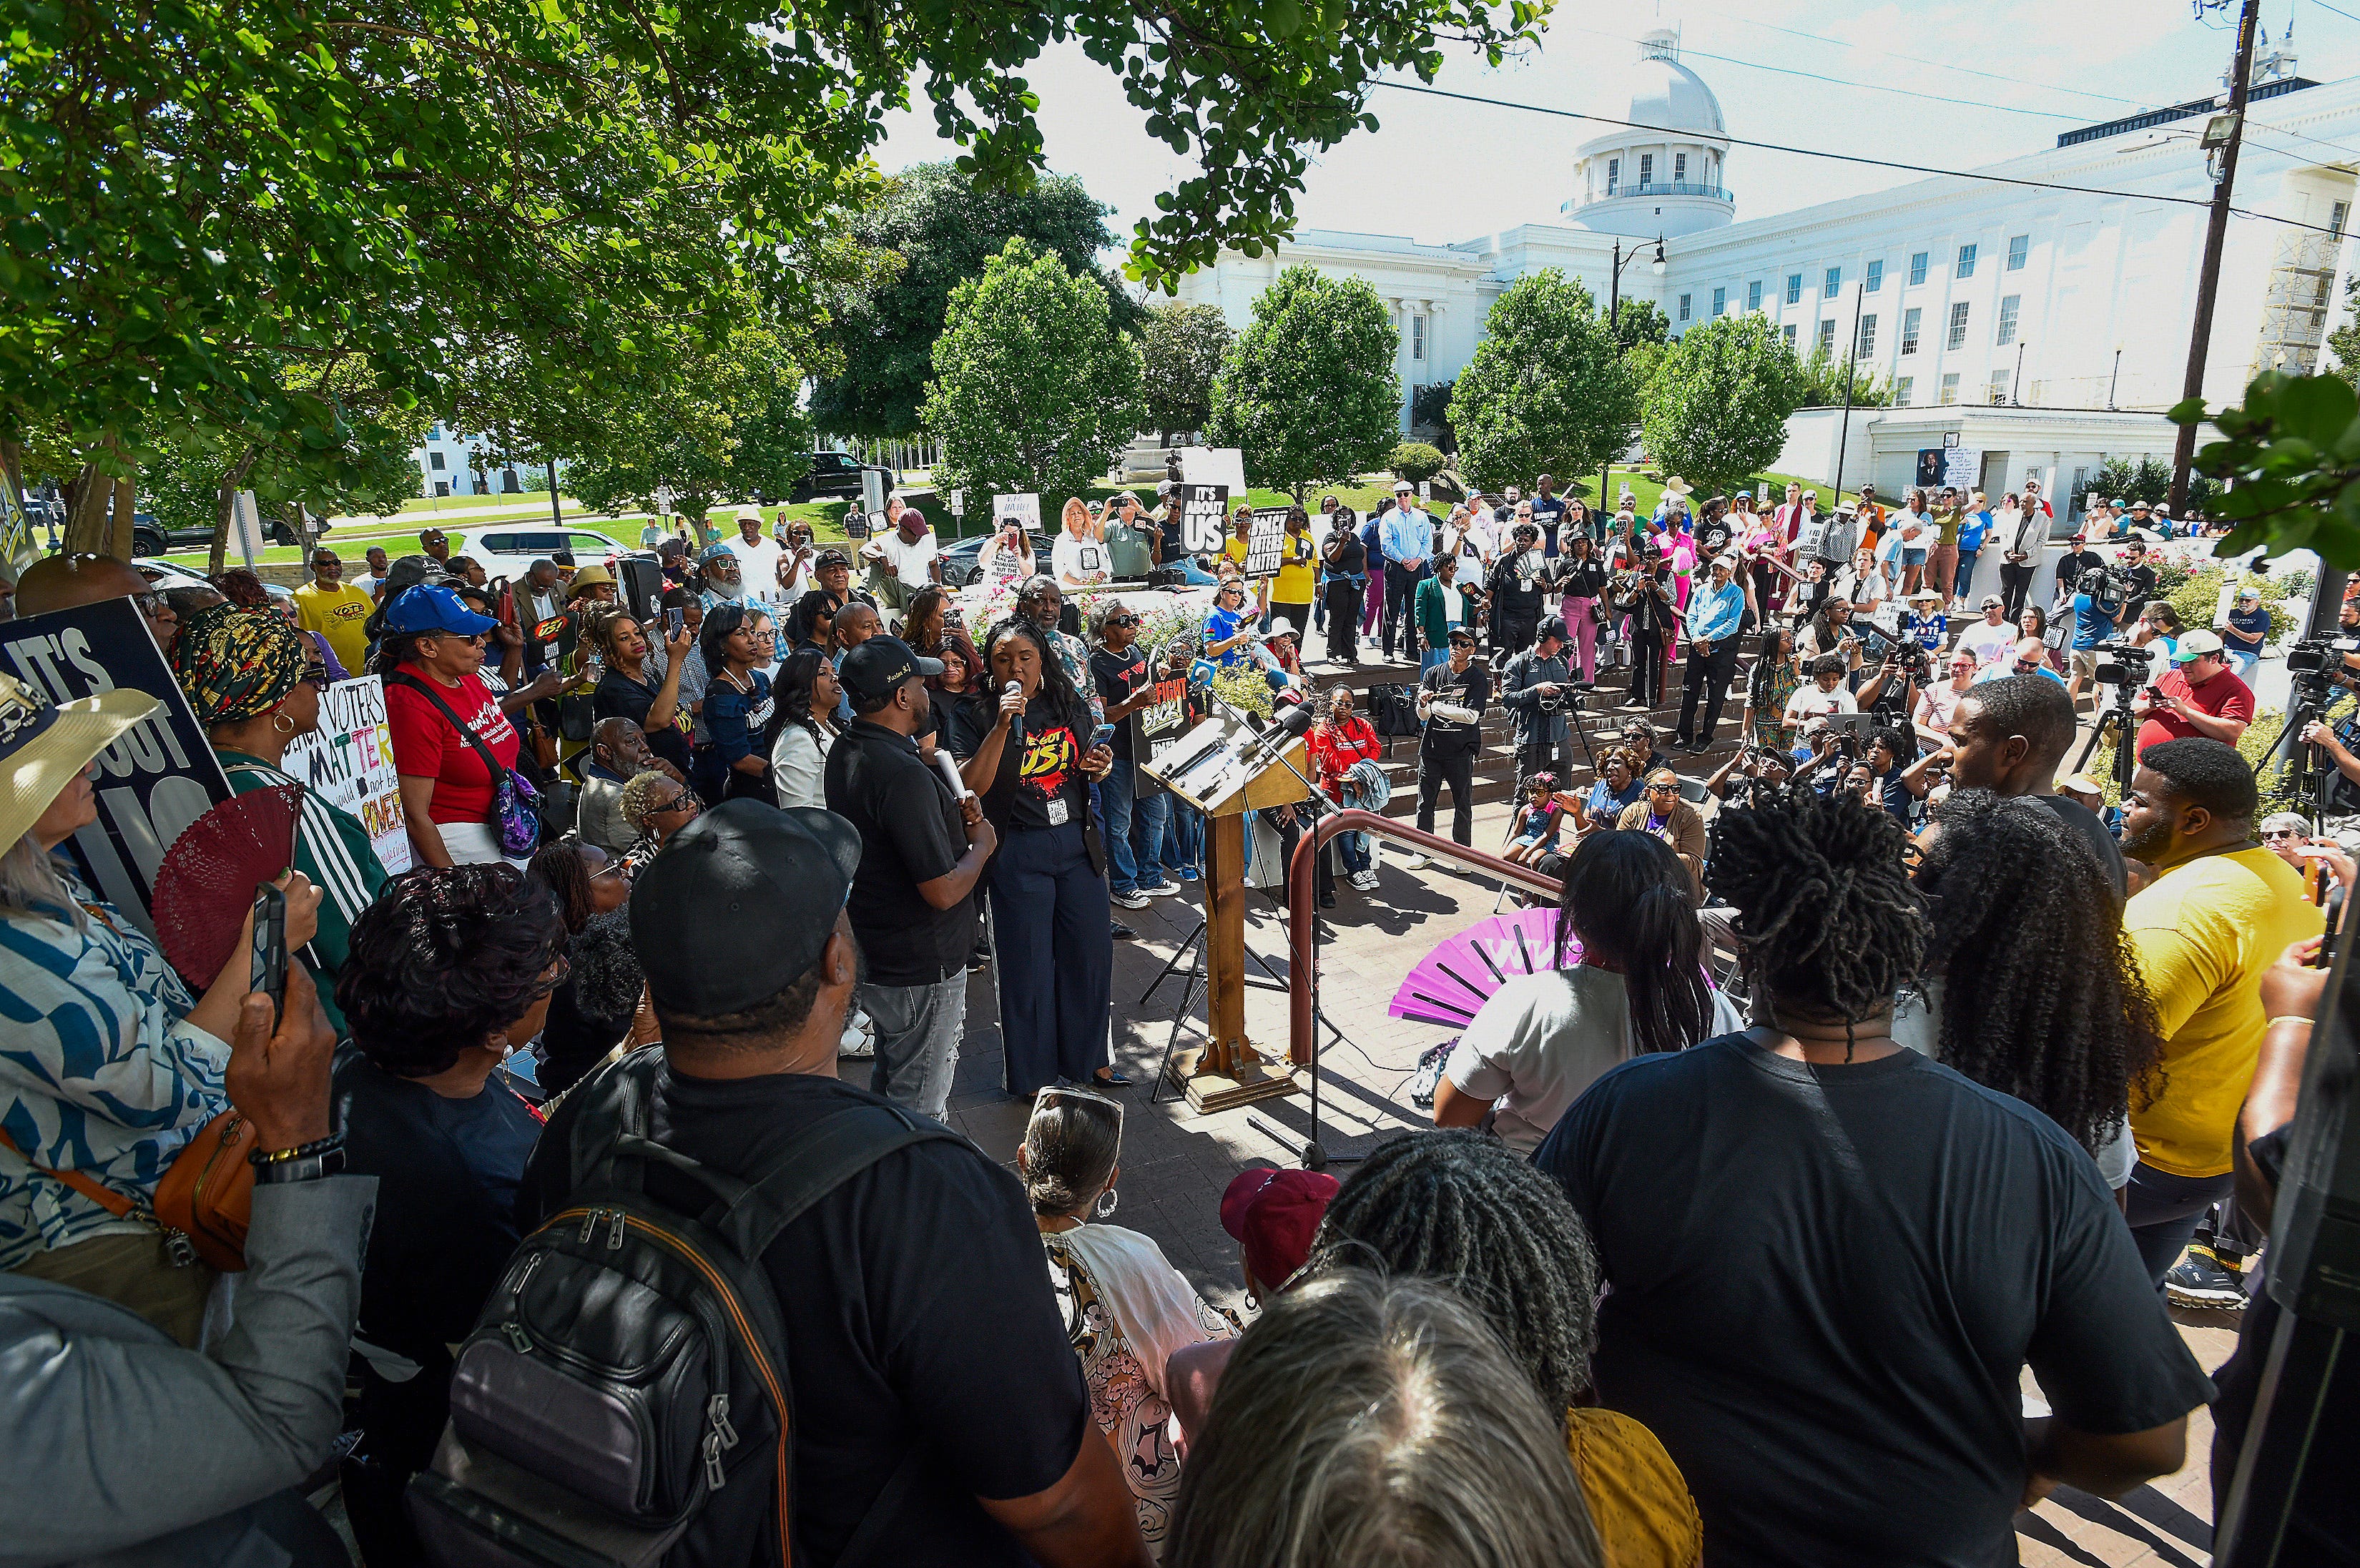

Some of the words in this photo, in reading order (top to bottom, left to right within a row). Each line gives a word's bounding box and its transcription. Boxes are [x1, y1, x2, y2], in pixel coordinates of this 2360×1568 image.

[1194, 486, 1217, 501] IT'S
[1185, 501, 1225, 516] ABOUT
[1184, 514, 1224, 551] US
[1249, 533, 1285, 556] VOTERS
[333, 604, 364, 616] VOTE
[1913, 626, 1939, 636] VOTE
[4, 626, 115, 709] IT'S
[1156, 677, 1187, 706] FIGHT
[322, 679, 384, 734] VOTERS
[1142, 695, 1184, 731] BACK!
[1039, 730, 1063, 745] GOT
[1019, 740, 1069, 776] US!
[369, 779, 384, 795] not
